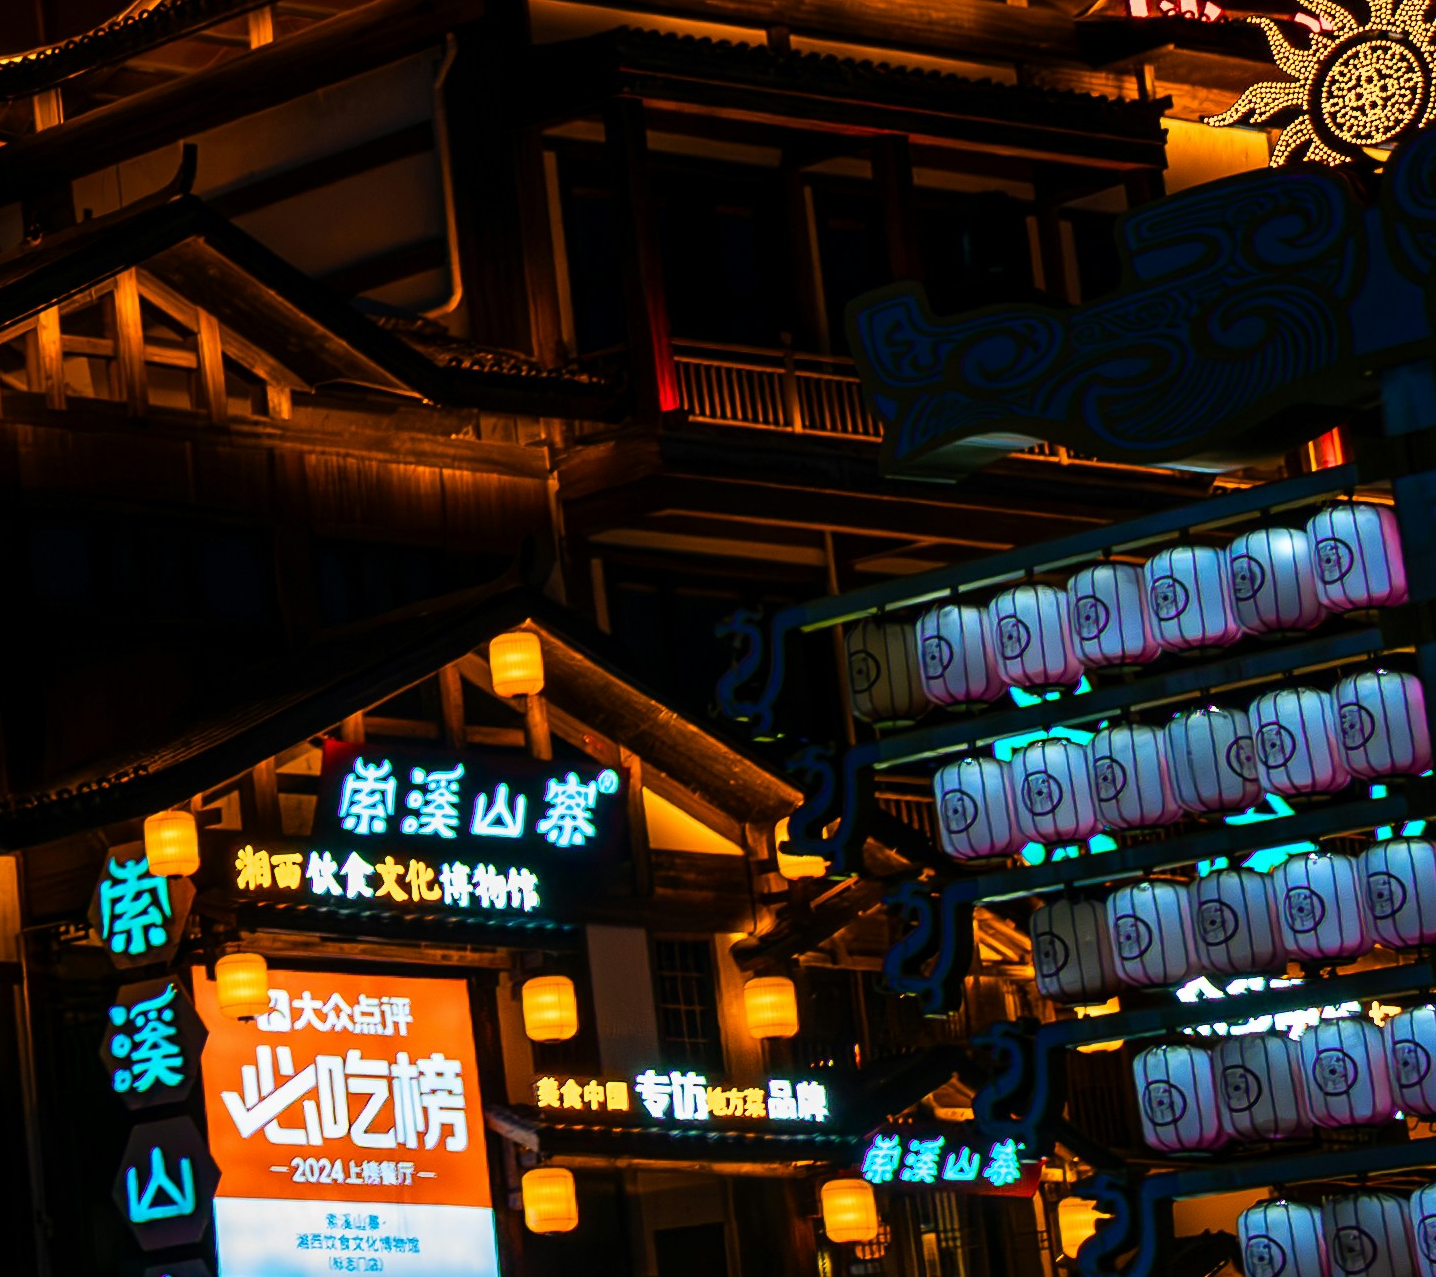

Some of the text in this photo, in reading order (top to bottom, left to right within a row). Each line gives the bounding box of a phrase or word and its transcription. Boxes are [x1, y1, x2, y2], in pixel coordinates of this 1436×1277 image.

[338, 756, 598, 847] 索溪山寨
[234, 844, 541, 912] 湘西饮食文化博物馆
[293, 991, 414, 1037] 大众点评
[99, 856, 196, 1277] 索溪山
[220, 1044, 469, 1152] 必吃榜
